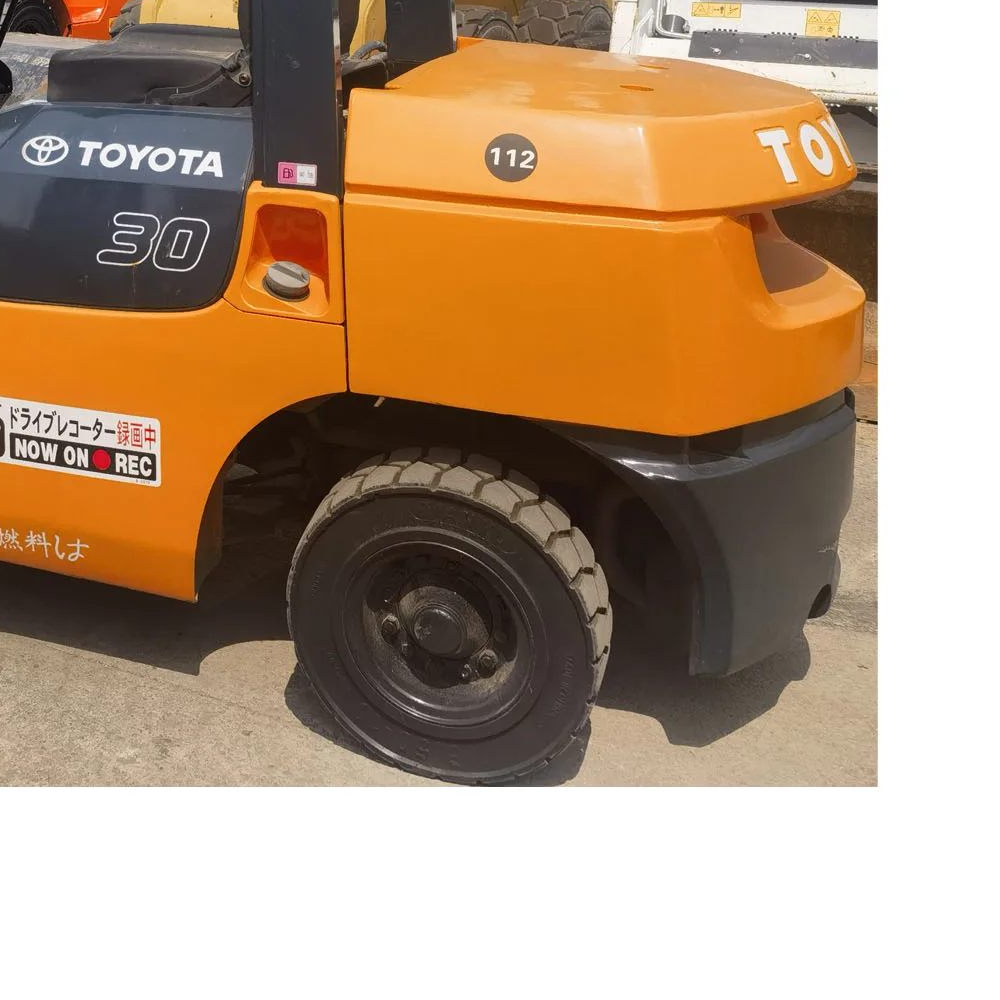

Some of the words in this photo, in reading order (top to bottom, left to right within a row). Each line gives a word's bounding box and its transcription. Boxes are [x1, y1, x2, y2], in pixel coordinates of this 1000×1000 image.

[78, 140, 224, 178] TOYOTA
[490, 147, 535, 169] 112
[757, 117, 852, 184] TOY
[96, 211, 210, 273] 30
[15, 437, 59, 463] NOW
[64, 445, 89, 469] ON
[115, 452, 152, 477] REC
